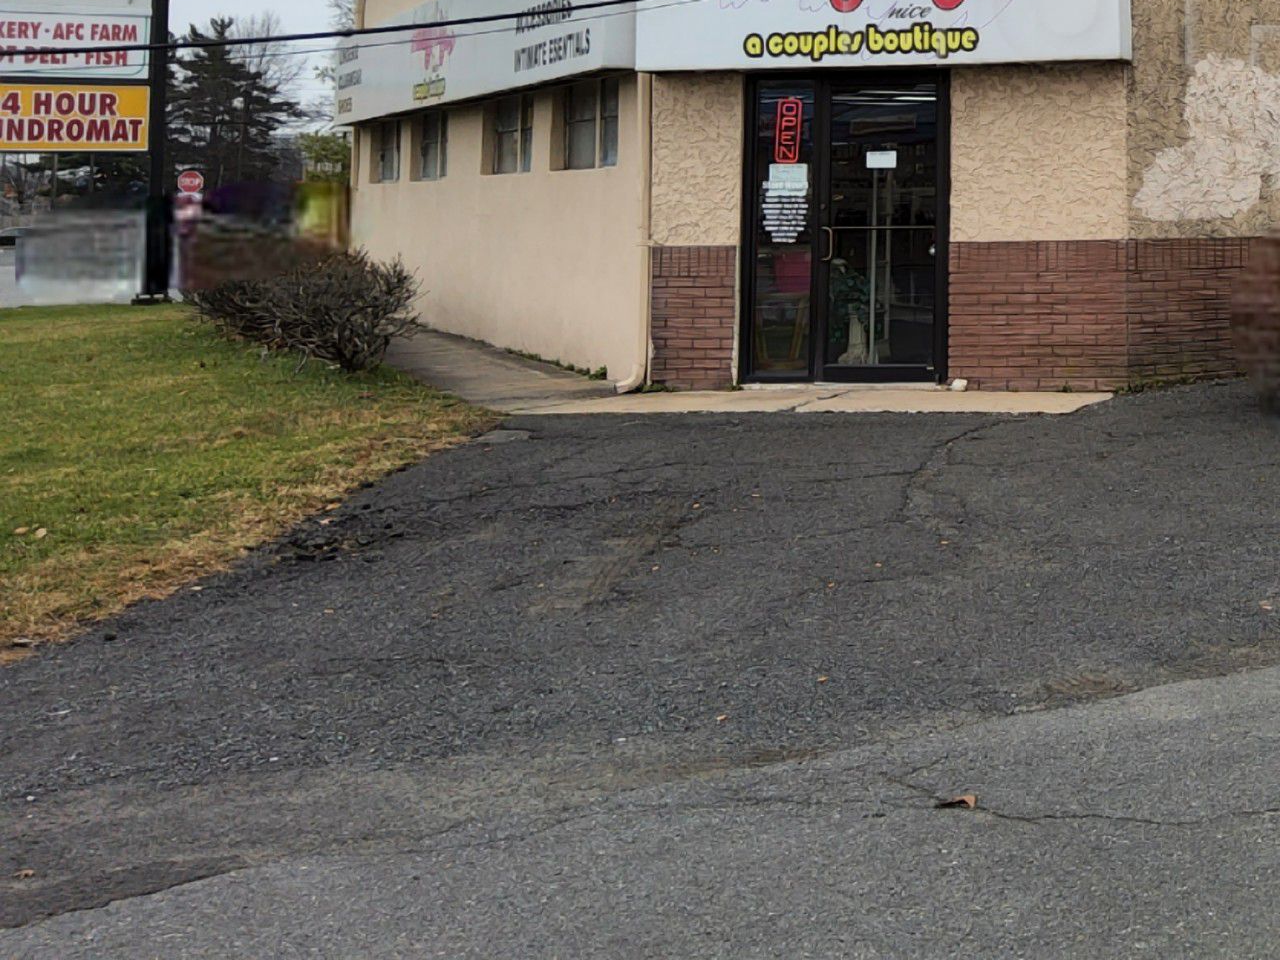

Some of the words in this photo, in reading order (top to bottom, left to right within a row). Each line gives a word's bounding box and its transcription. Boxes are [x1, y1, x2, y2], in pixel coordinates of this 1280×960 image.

[888, 3, 933, 19] nice
[52, 22, 84, 41] AFC
[90, 23, 137, 42] FARM
[744, 31, 765, 58] a
[767, 22, 863, 60] couples
[865, 21, 979, 59] boutique
[24, 46, 67, 65] DELI
[85, 48, 128, 66] FISH
[33, 92, 117, 116] HOUR
[0, 118, 143, 142] NDROMAT
[778, 102, 799, 161] OPEN
